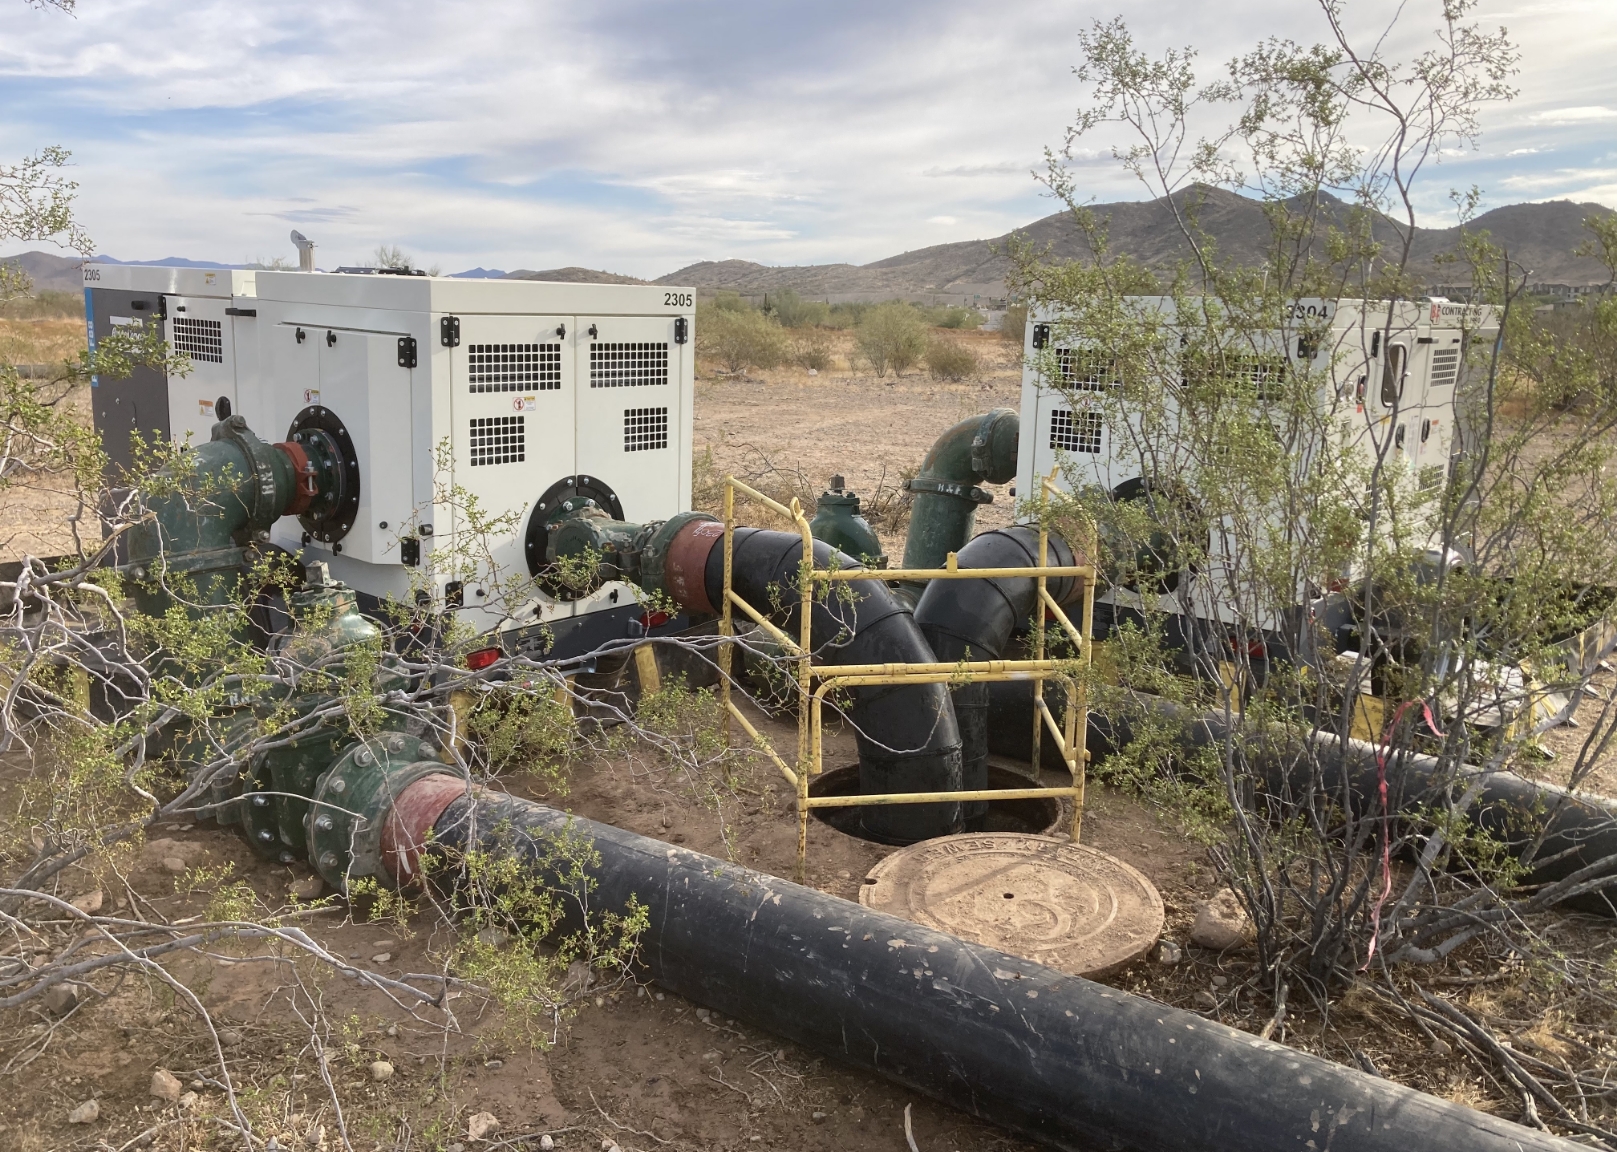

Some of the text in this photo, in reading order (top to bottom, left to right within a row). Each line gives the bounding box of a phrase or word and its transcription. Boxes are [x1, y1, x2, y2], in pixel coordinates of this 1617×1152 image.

[84, 268, 101, 281] 2305
[663, 292, 693, 307] 2305
[1441, 306, 1482, 316] CONTRACTNG
